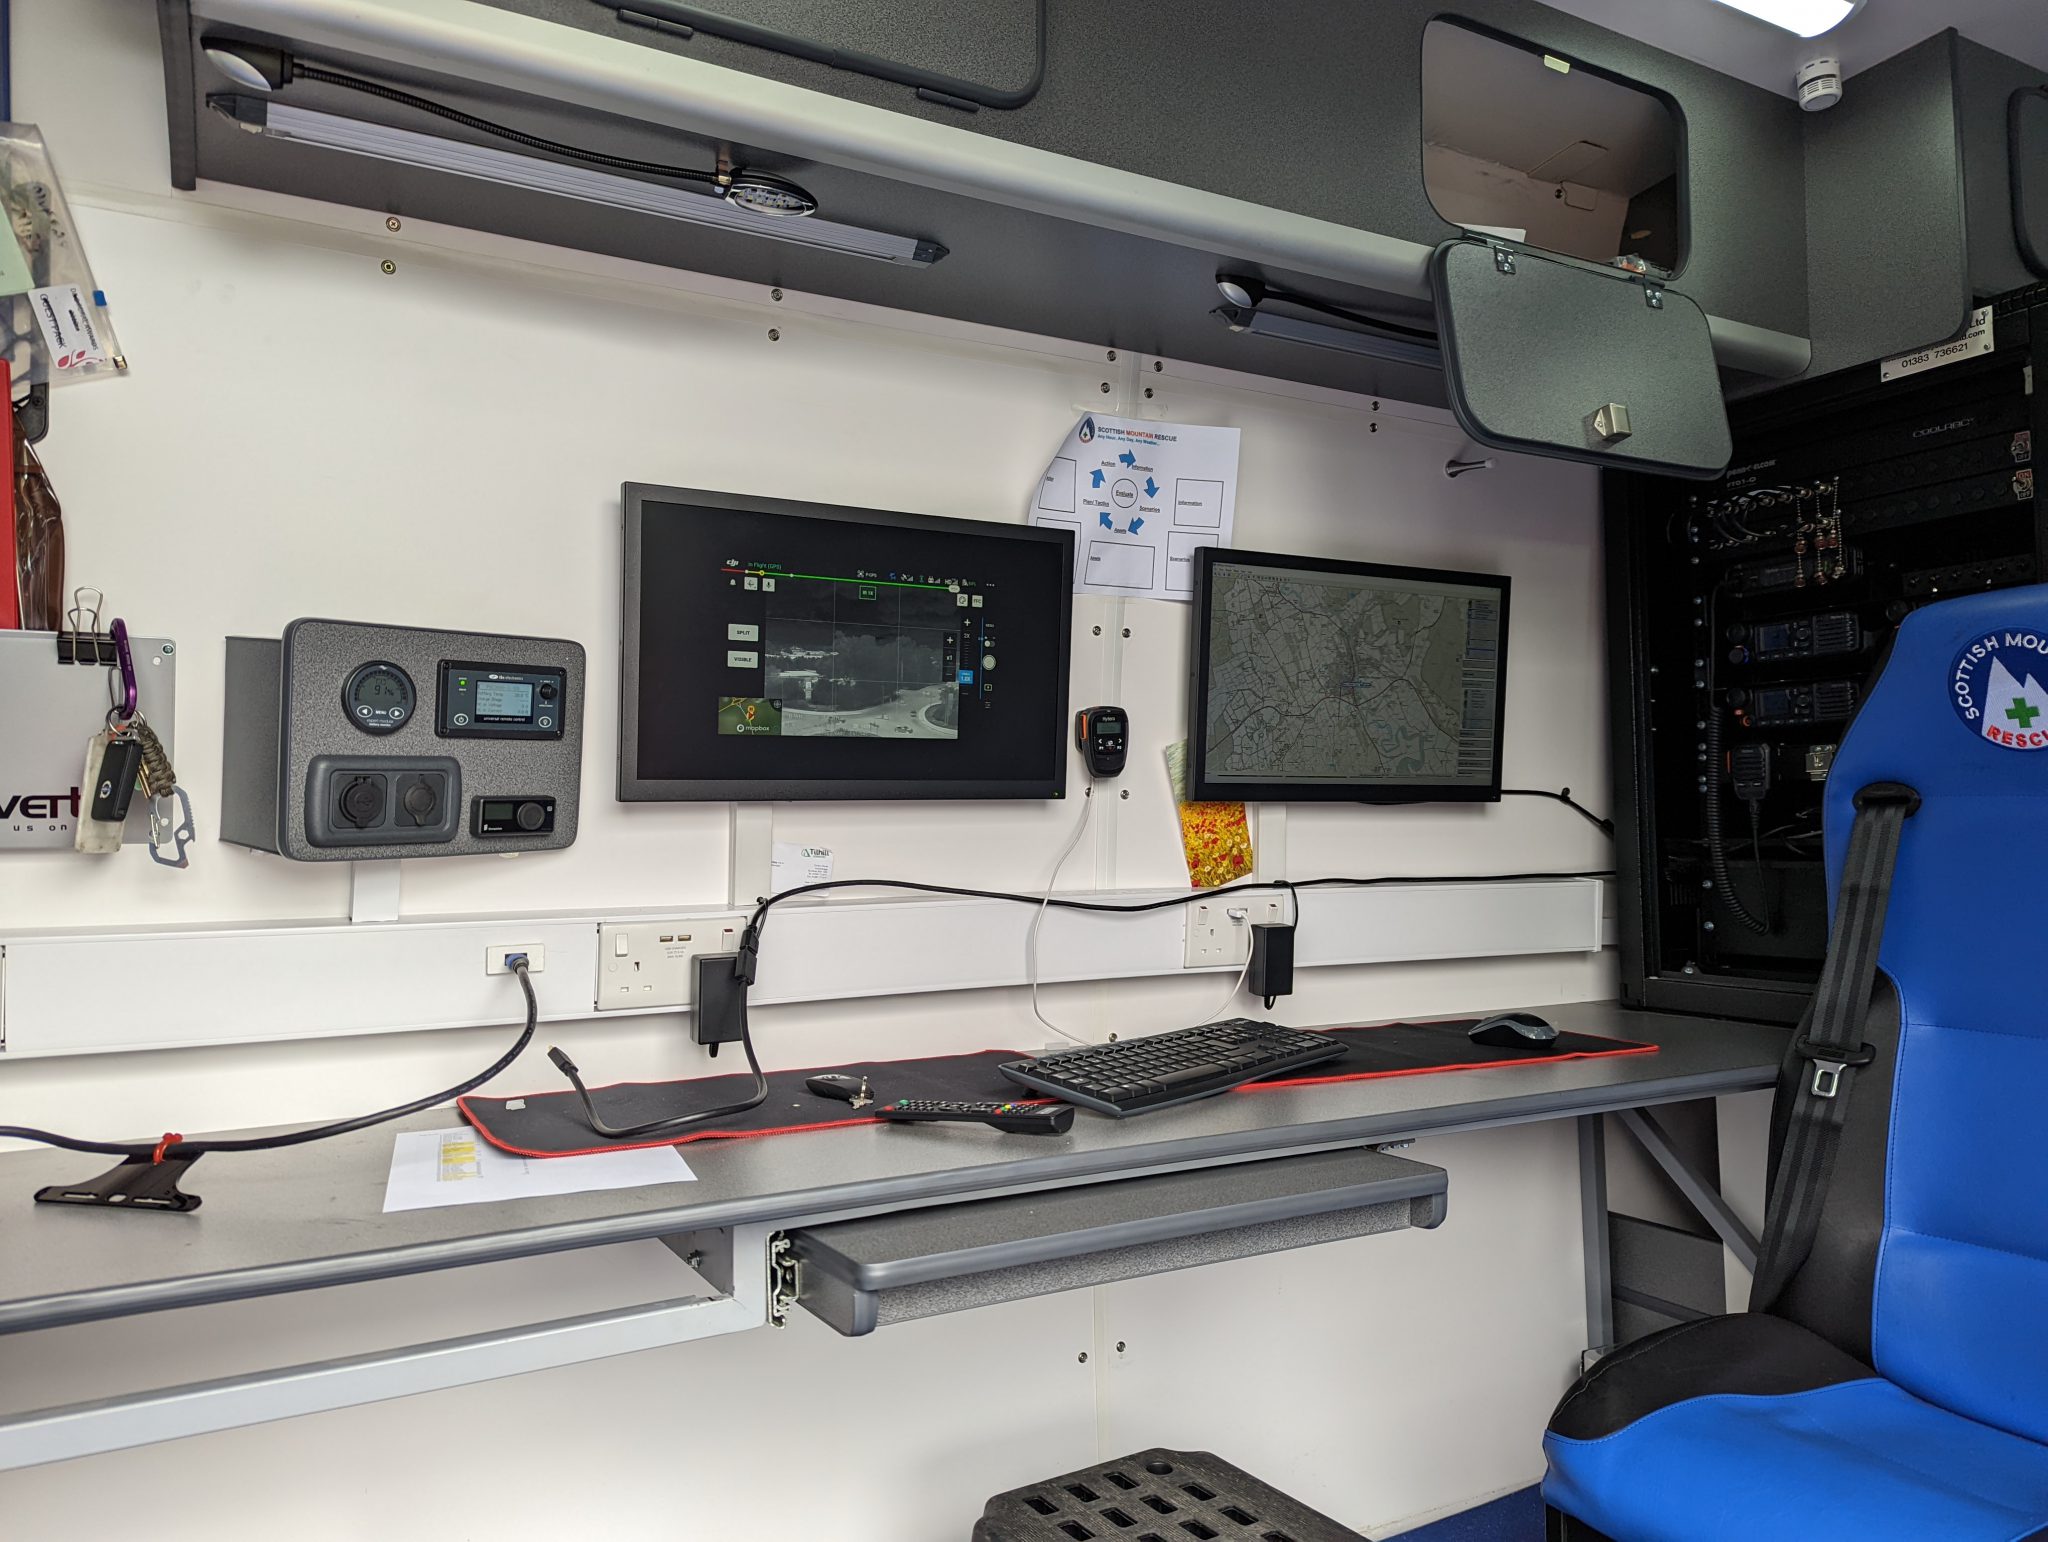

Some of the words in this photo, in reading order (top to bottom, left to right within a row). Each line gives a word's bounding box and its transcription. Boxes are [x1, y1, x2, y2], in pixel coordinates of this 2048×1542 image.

[1901, 353, 1930, 368] 01383
[1934, 342, 1968, 359] 736621
[1097, 426, 1126, 436] SCOTTISH
[1126, 430, 1154, 439] MOUNTAIN
[1154, 433, 1178, 442] RESCUE
[1115, 489, 1134, 498] Evaluate
[1954, 635, 2000, 720] SCOTTISH
[745, 725, 770, 733] mapbox
[809, 848, 830, 857] Tilhill
